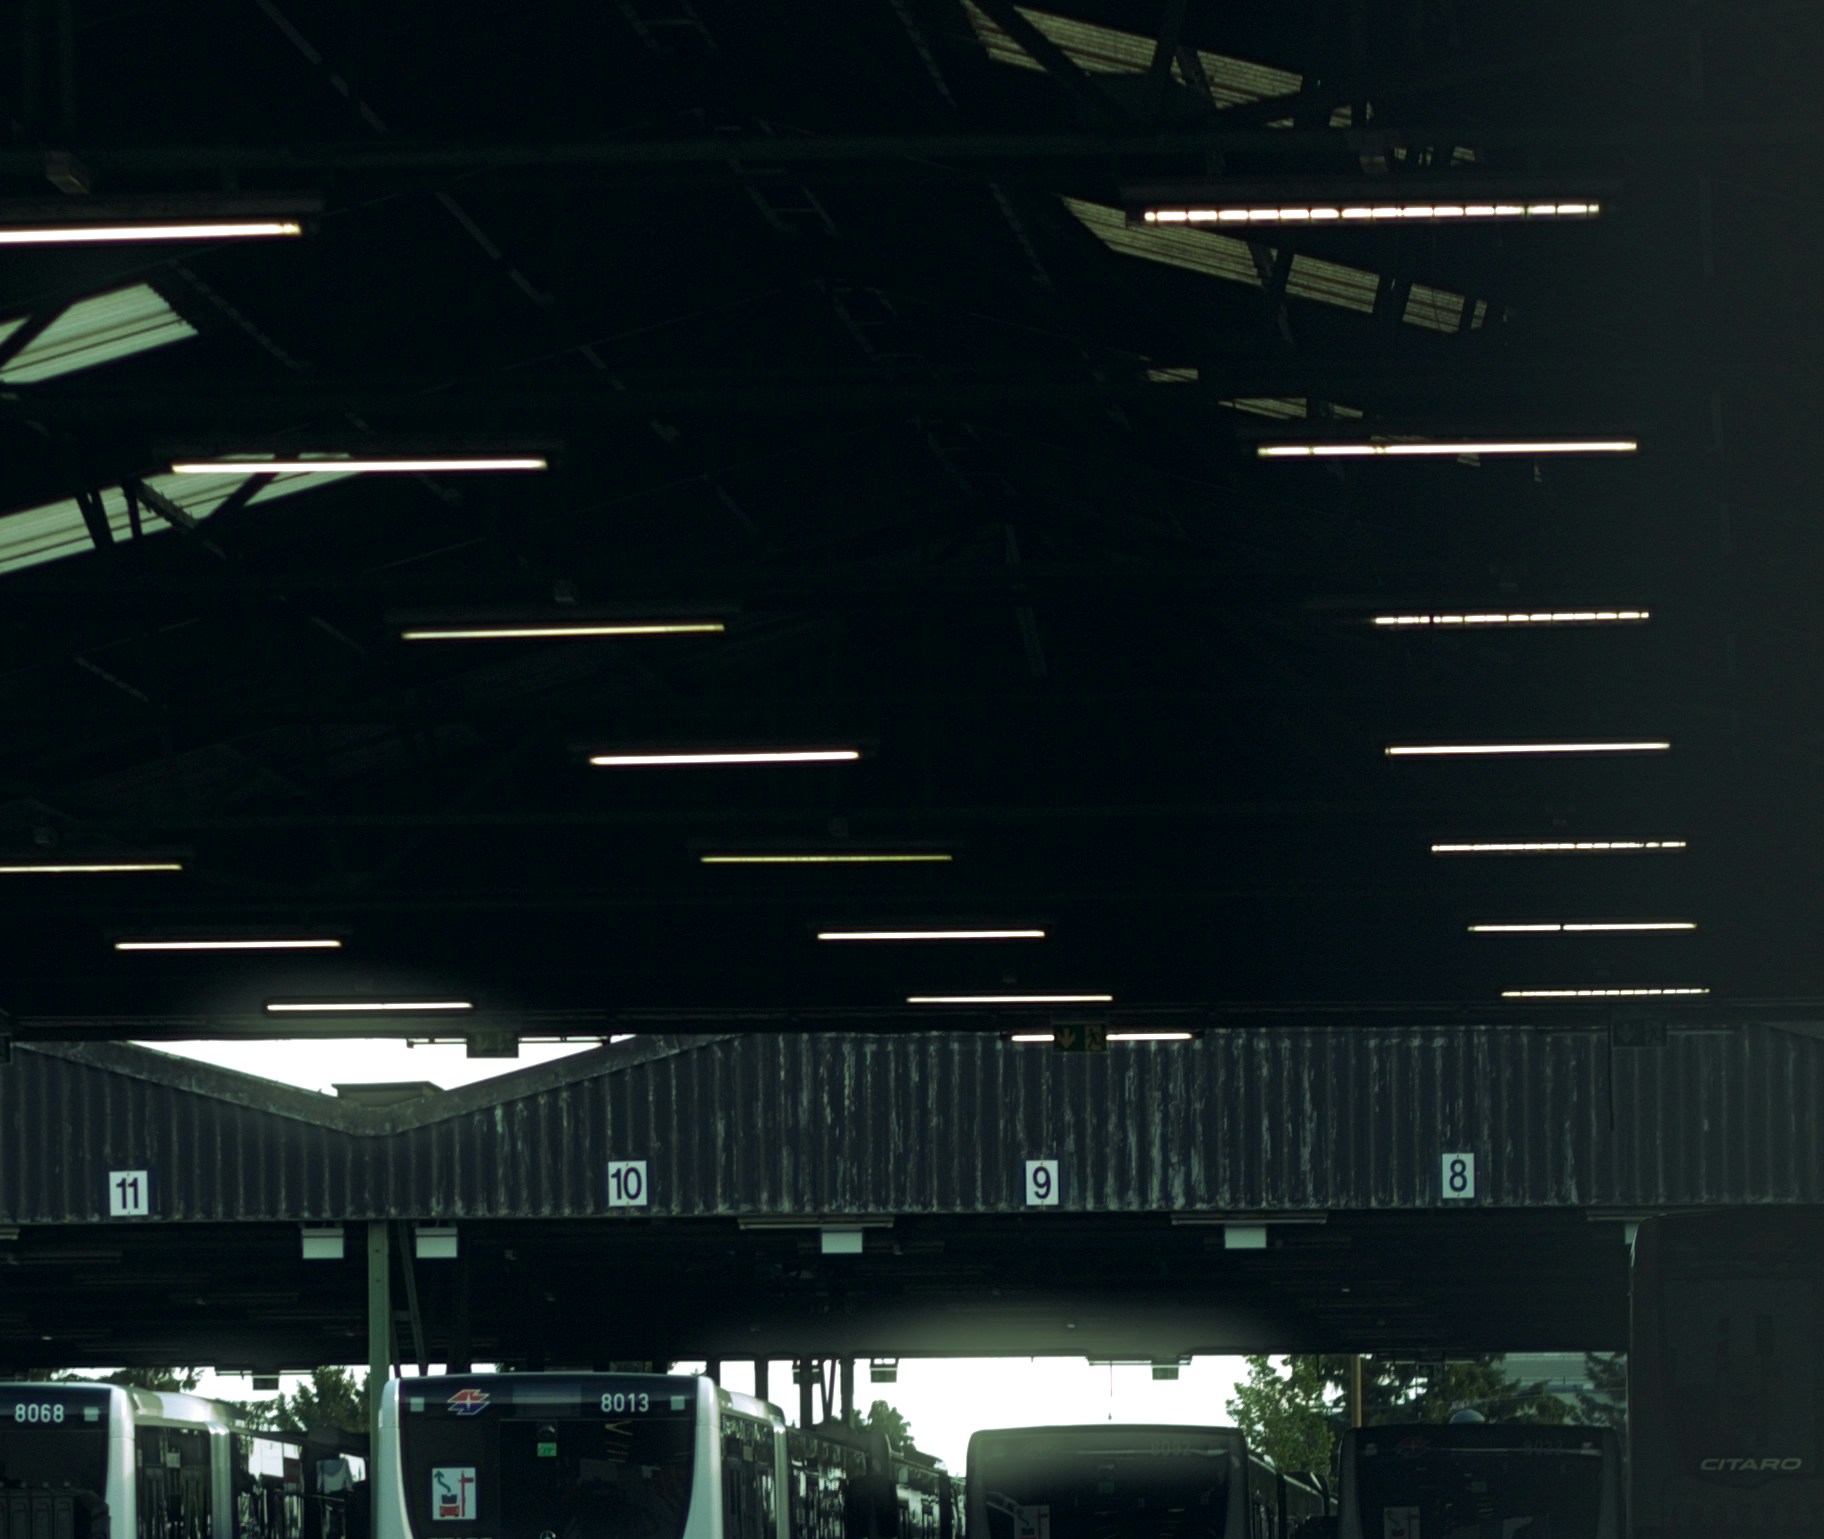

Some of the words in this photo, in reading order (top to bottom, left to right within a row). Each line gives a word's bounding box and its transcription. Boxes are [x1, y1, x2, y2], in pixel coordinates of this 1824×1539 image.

[611, 1166, 643, 1201] 10
[1032, 1165, 1052, 1200] 9
[1449, 1158, 1468, 1193] 8
[116, 1177, 139, 1209] 11
[14, 1403, 64, 1423] 8068
[601, 1393, 650, 1412] 8013
[1699, 1457, 1803, 1471] CITARO
